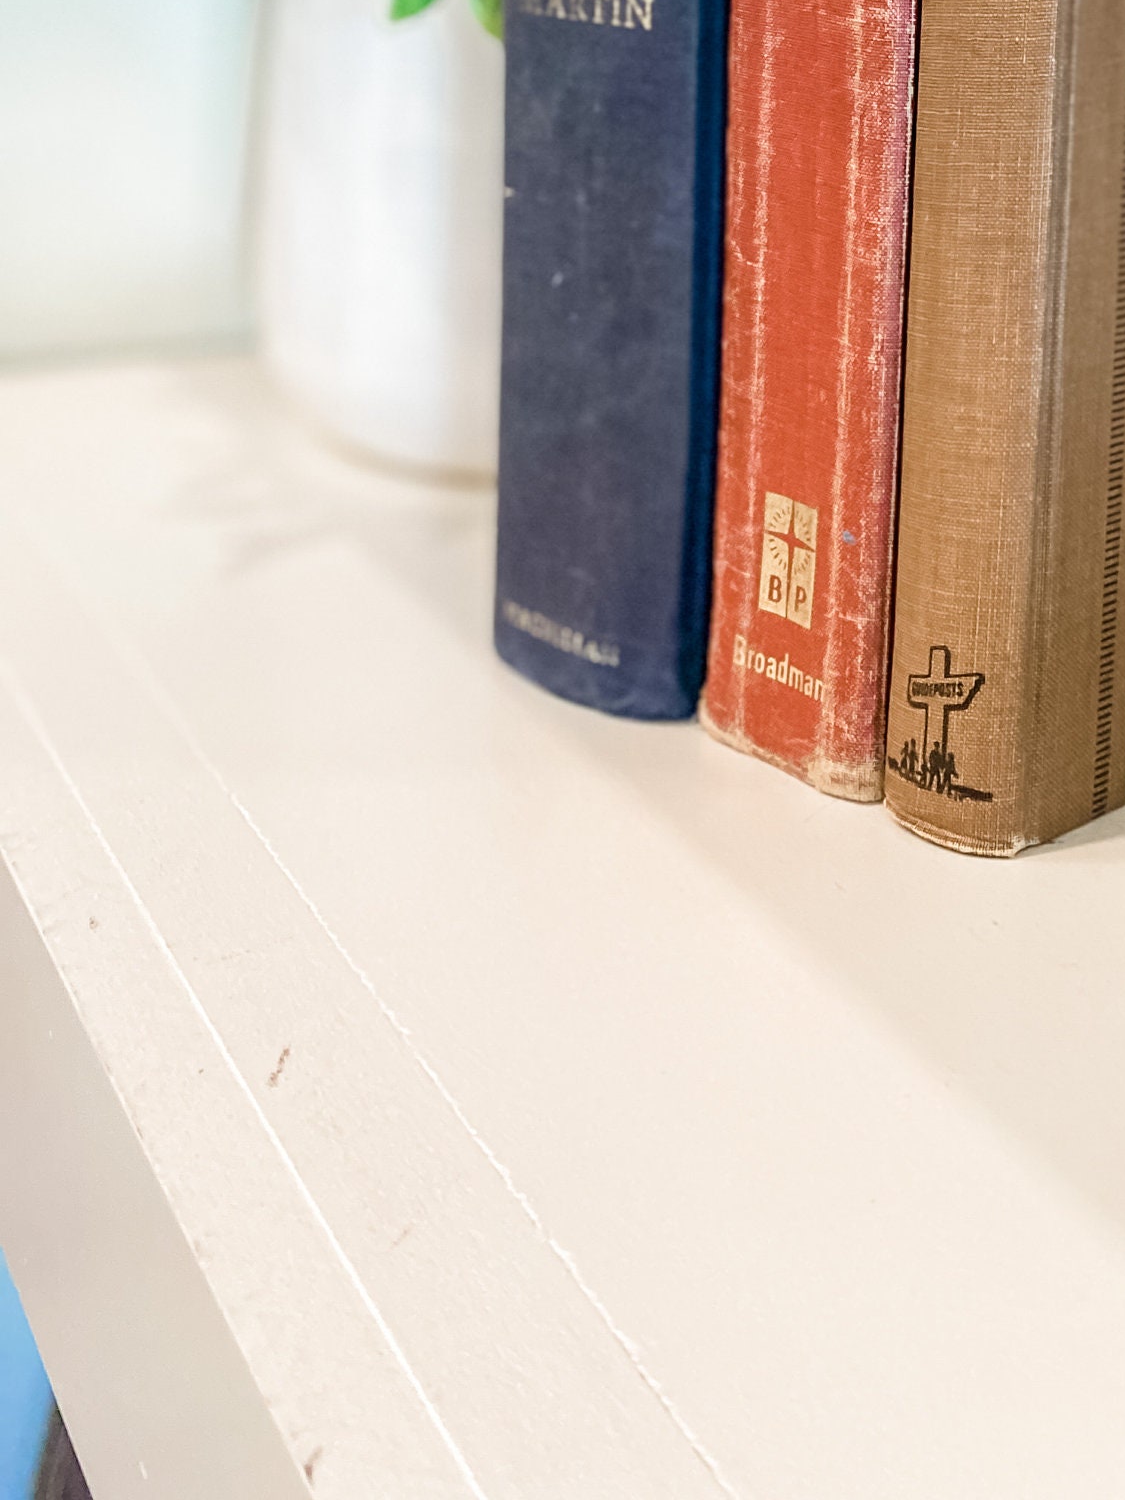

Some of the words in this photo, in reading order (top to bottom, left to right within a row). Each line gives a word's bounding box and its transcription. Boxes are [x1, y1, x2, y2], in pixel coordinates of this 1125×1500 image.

[768, 574, 782, 603] B
[794, 585, 807, 612] P
[733, 633, 824, 703] Broadman
